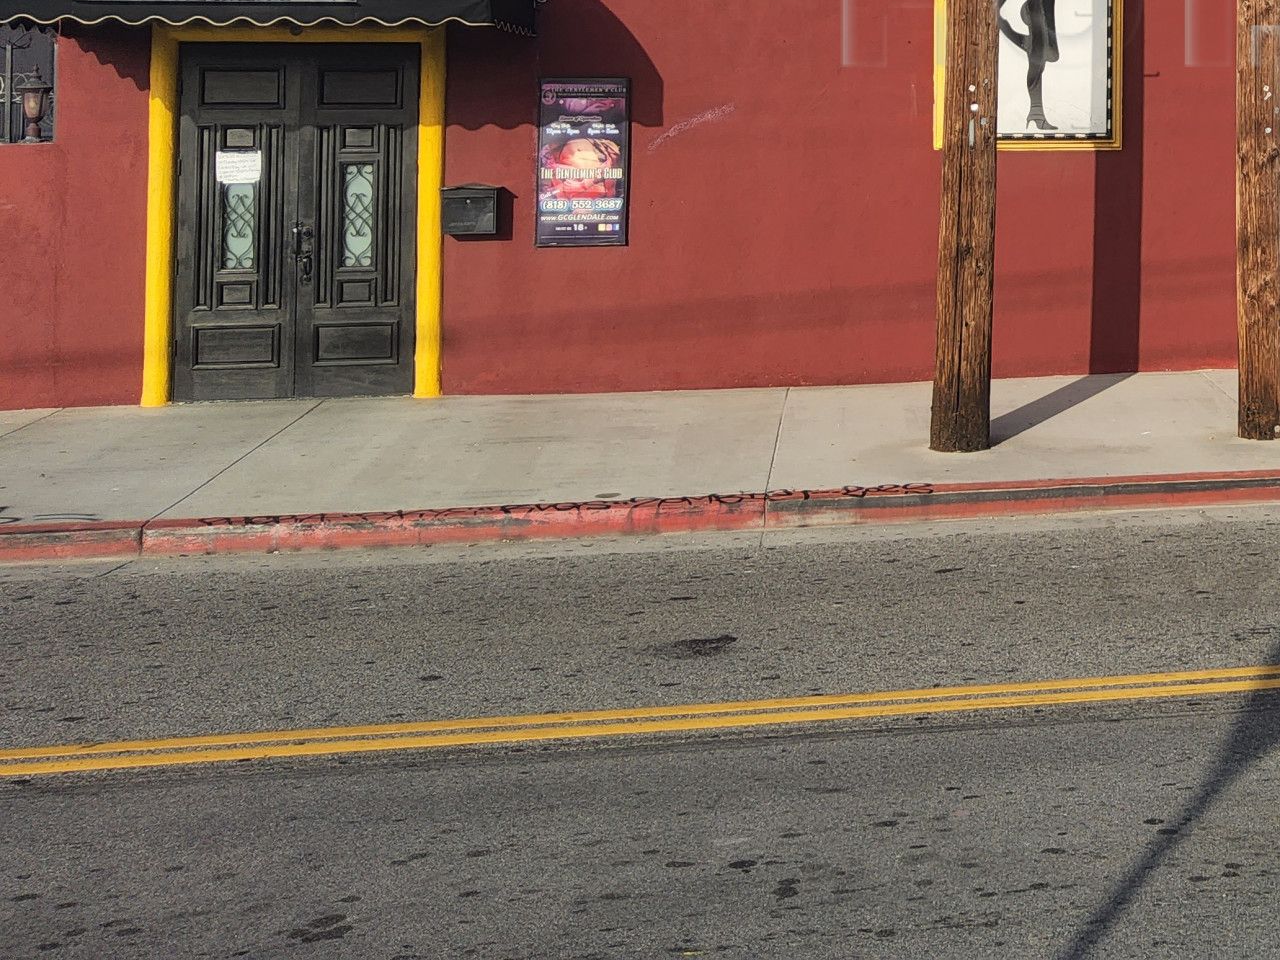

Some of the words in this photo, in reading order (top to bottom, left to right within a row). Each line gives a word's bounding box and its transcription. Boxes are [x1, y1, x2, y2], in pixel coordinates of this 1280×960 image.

[543, 200, 567, 209] (818)
[571, 200, 592, 209] 552
[595, 200, 622, 209] 3687
